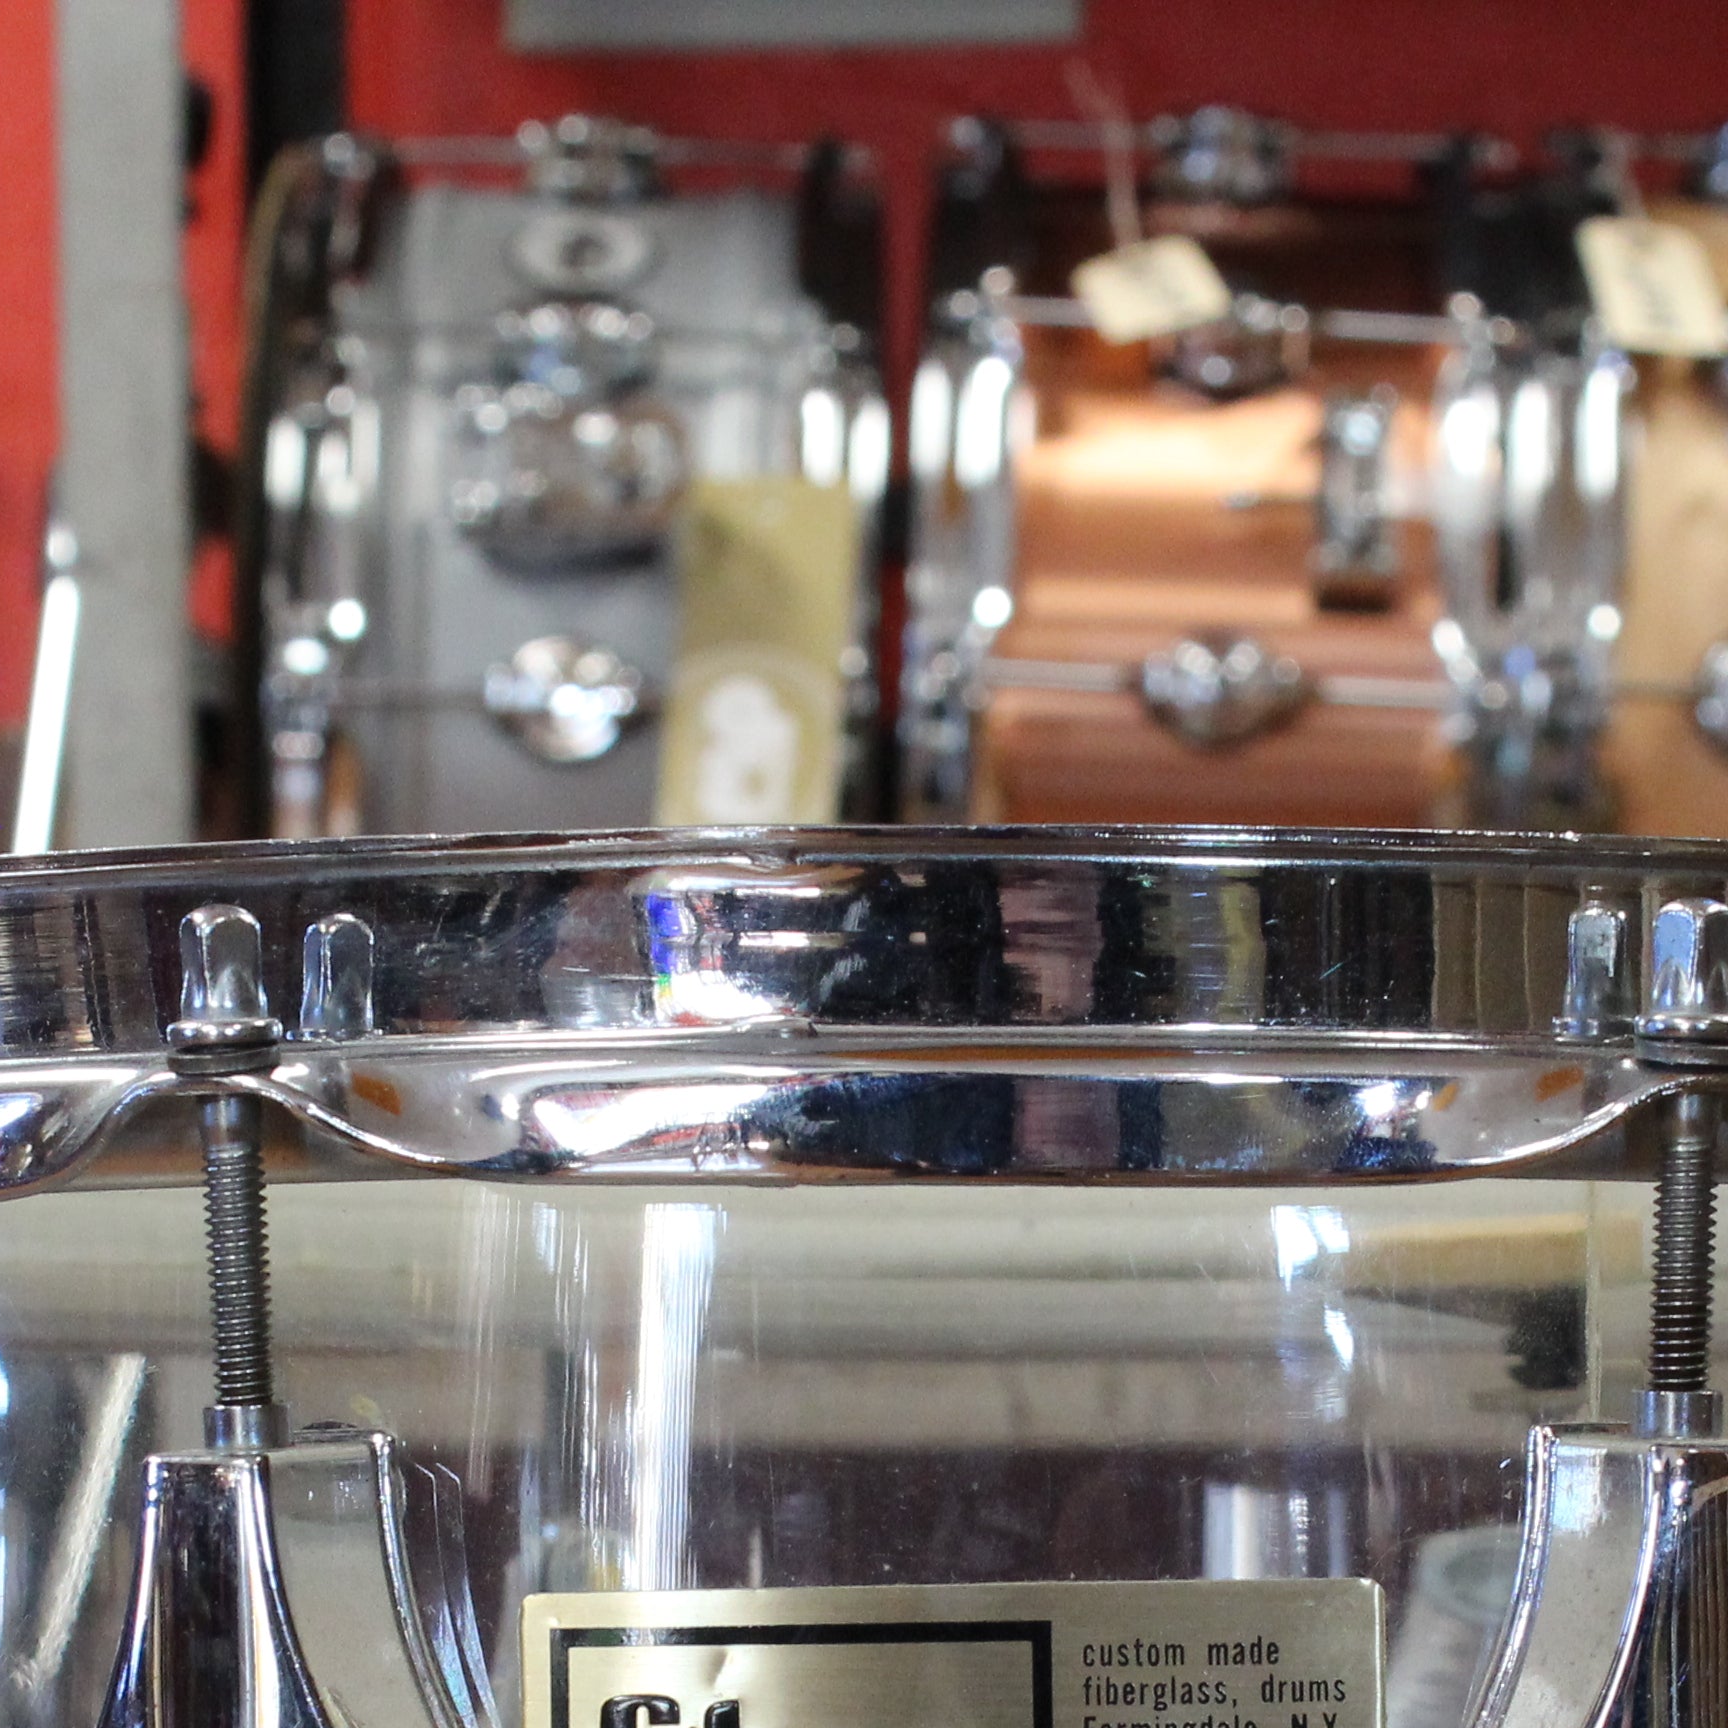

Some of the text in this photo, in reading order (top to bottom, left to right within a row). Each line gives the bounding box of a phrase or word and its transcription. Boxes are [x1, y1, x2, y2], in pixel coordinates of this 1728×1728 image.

[1081, 1635, 1281, 1668] custom made
[1082, 1674, 1347, 1712] fiberglass, drums
